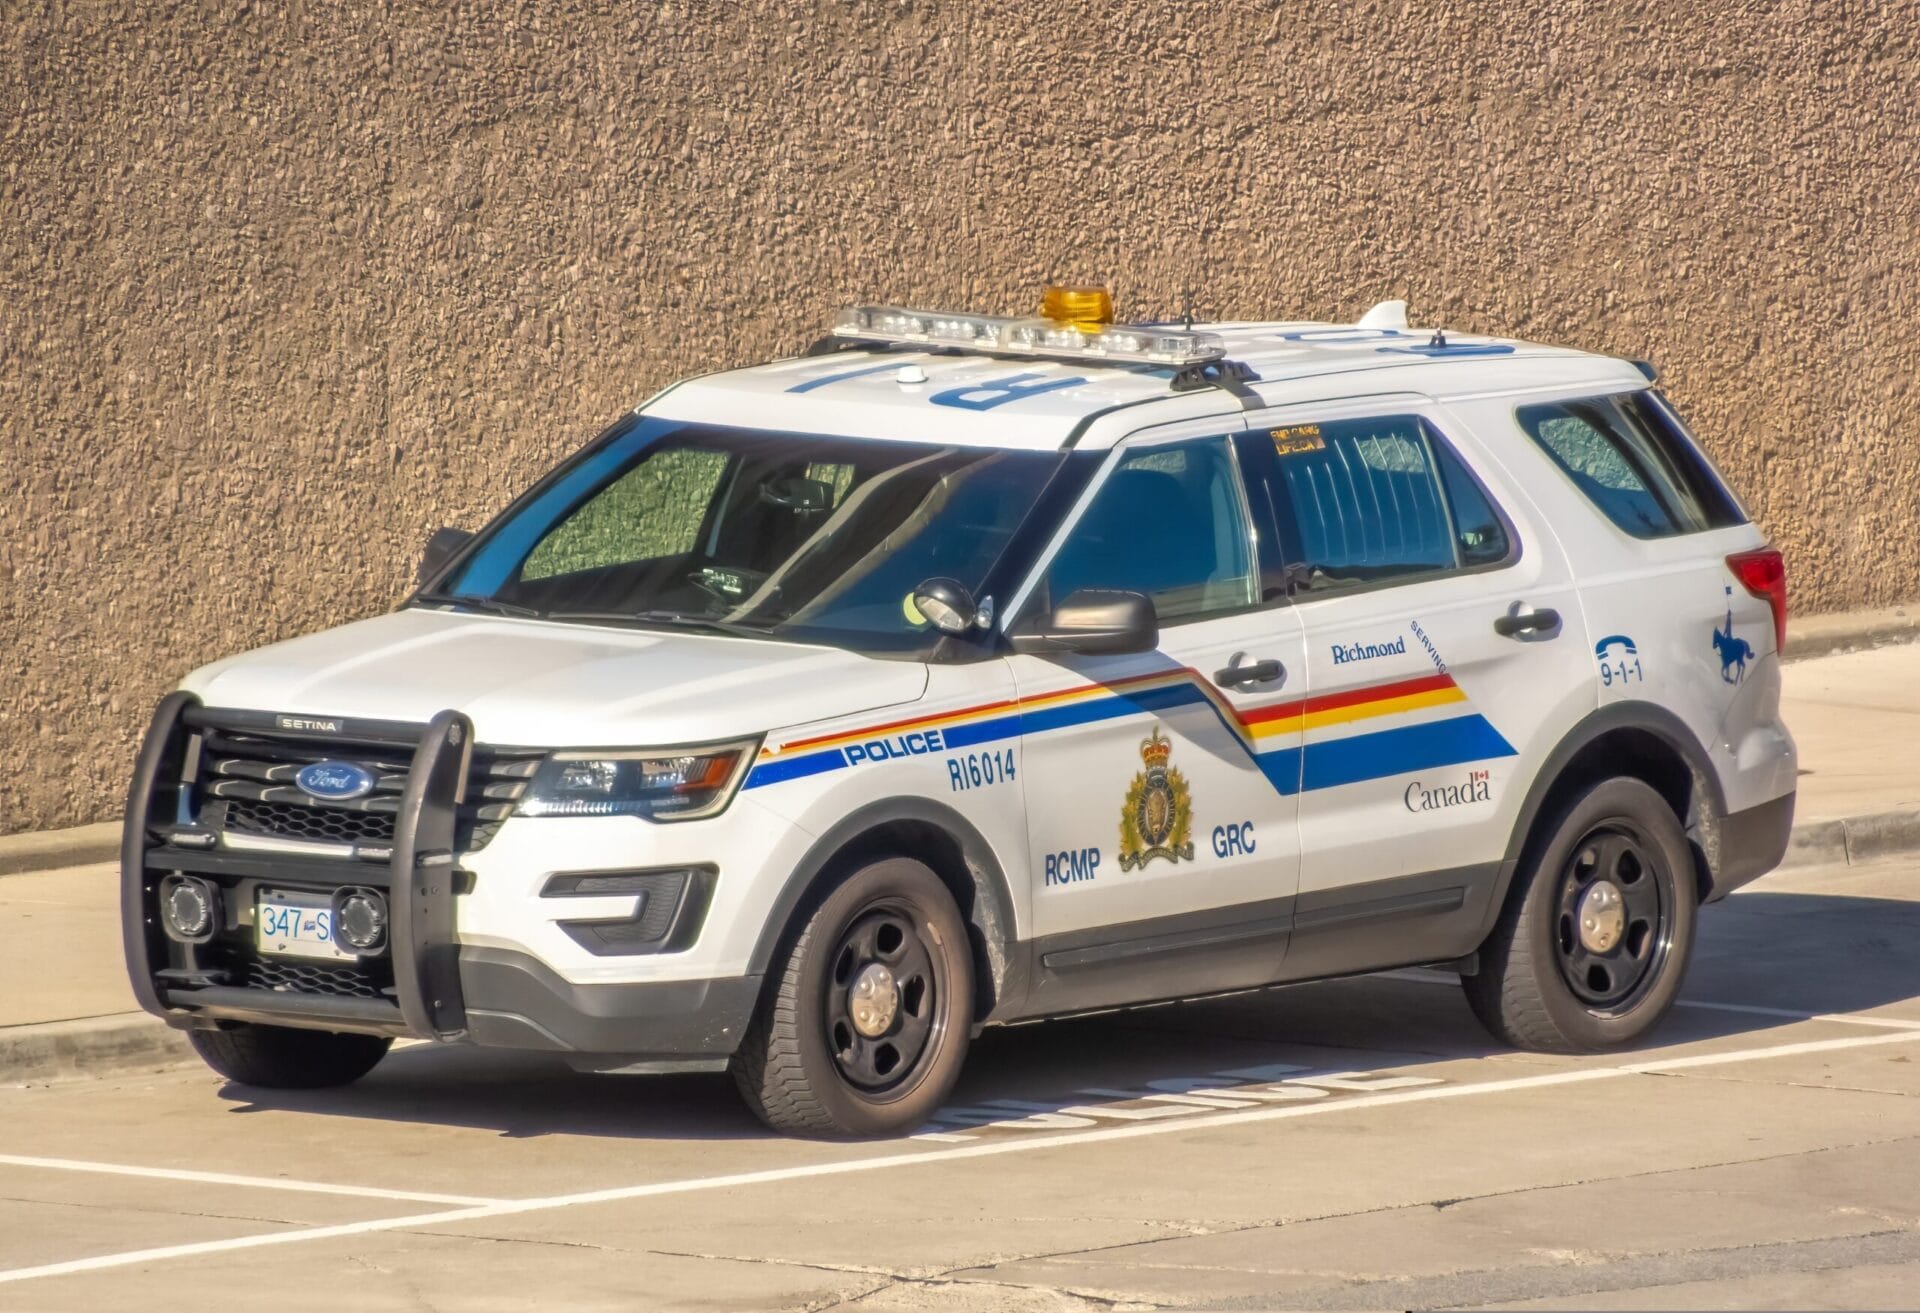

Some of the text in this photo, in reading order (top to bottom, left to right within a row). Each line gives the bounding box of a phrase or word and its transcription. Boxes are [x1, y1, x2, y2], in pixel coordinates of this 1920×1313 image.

[1331, 635, 1406, 665] Richmond
[1410, 620, 1447, 674] SERVING
[1601, 658, 1642, 687] 9-1-1
[282, 718, 337, 731] SETINA
[846, 729, 945, 767] POLICE
[308, 768, 351, 789] Ford
[947, 748, 1016, 792] RI6014
[1404, 771, 1491, 813] Canada
[1045, 847, 1101, 886] RCMP
[1211, 821, 1256, 859] GRC
